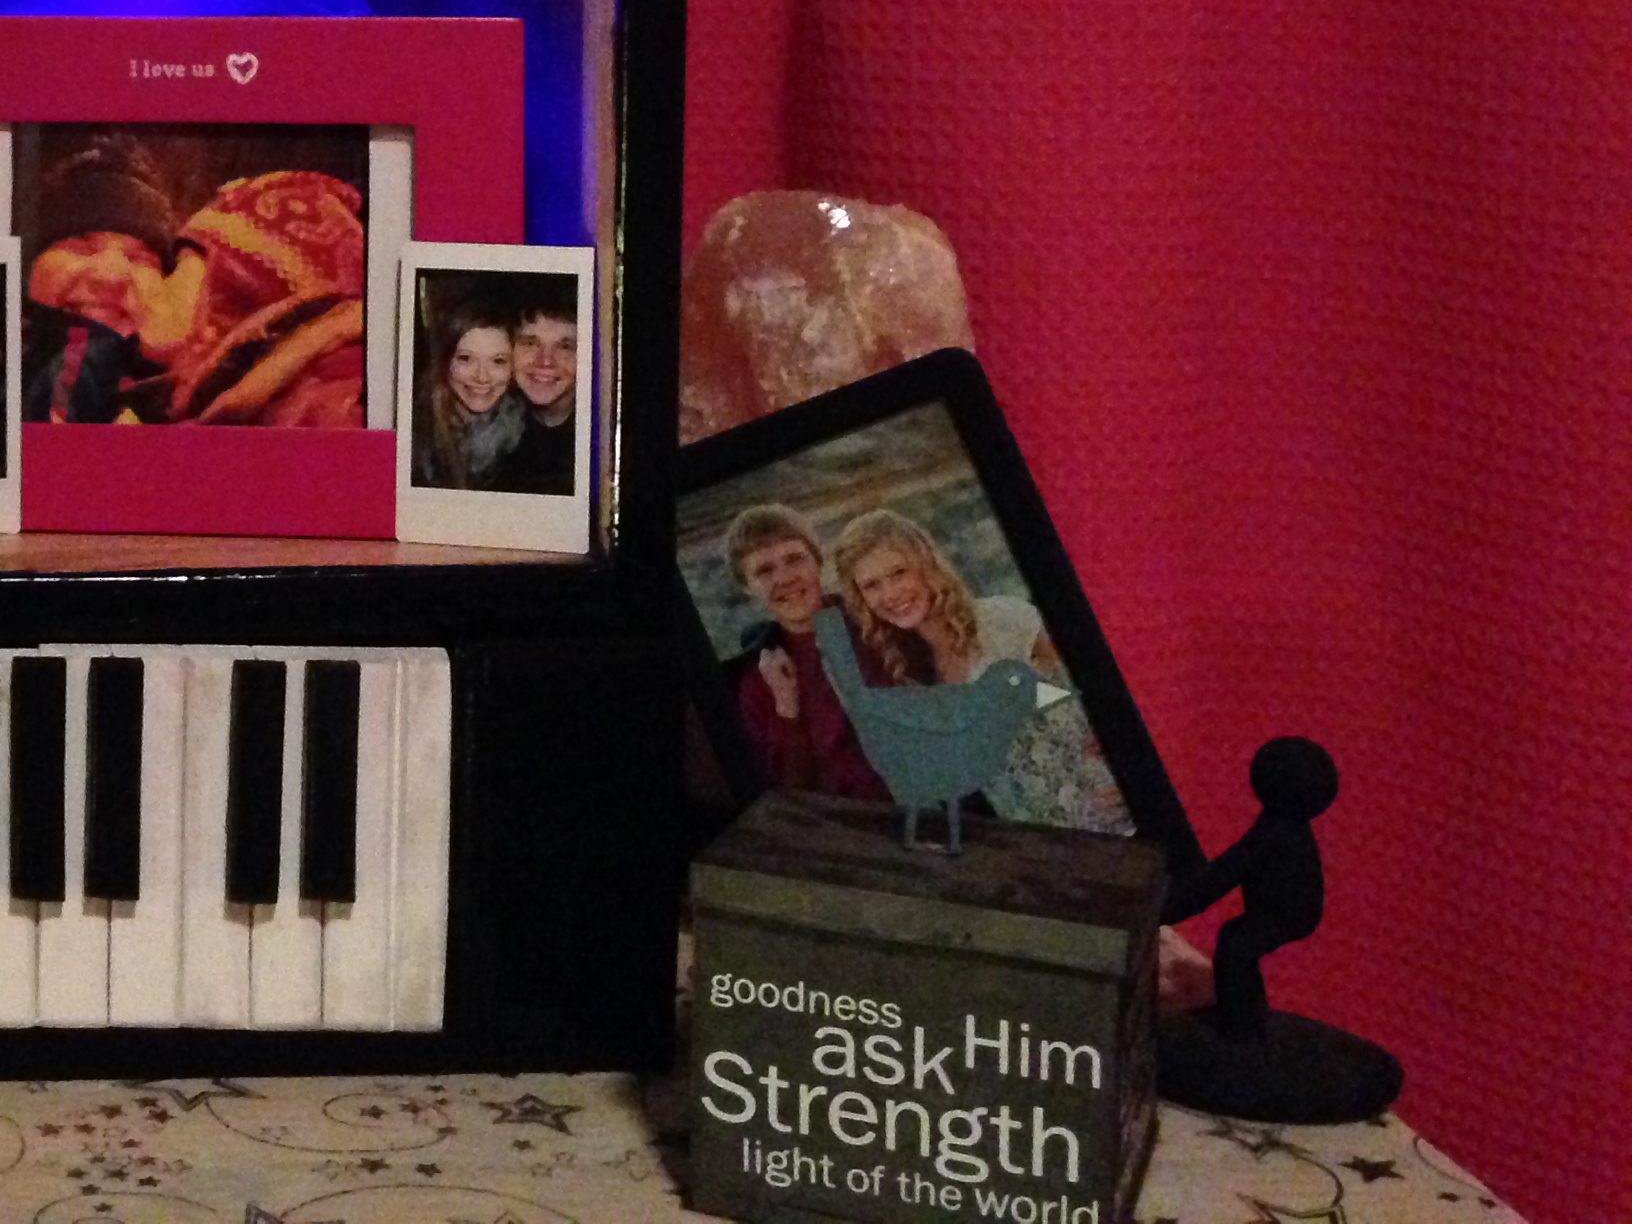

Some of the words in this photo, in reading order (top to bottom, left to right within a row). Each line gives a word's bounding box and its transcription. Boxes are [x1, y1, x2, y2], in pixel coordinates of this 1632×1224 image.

[128, 59, 138, 78] I
[143, 59, 186, 78] love
[191, 63, 215, 78] us
[709, 973, 903, 1028] goodness
[812, 1025, 956, 1096] ask
[965, 1014, 1102, 1090] Him
[701, 1050, 1080, 1184] Strength
[742, 1137, 837, 1188] light
[846, 1165, 886, 1196] of
[896, 1172, 963, 1210] the
[974, 1187, 1100, 1224] world
